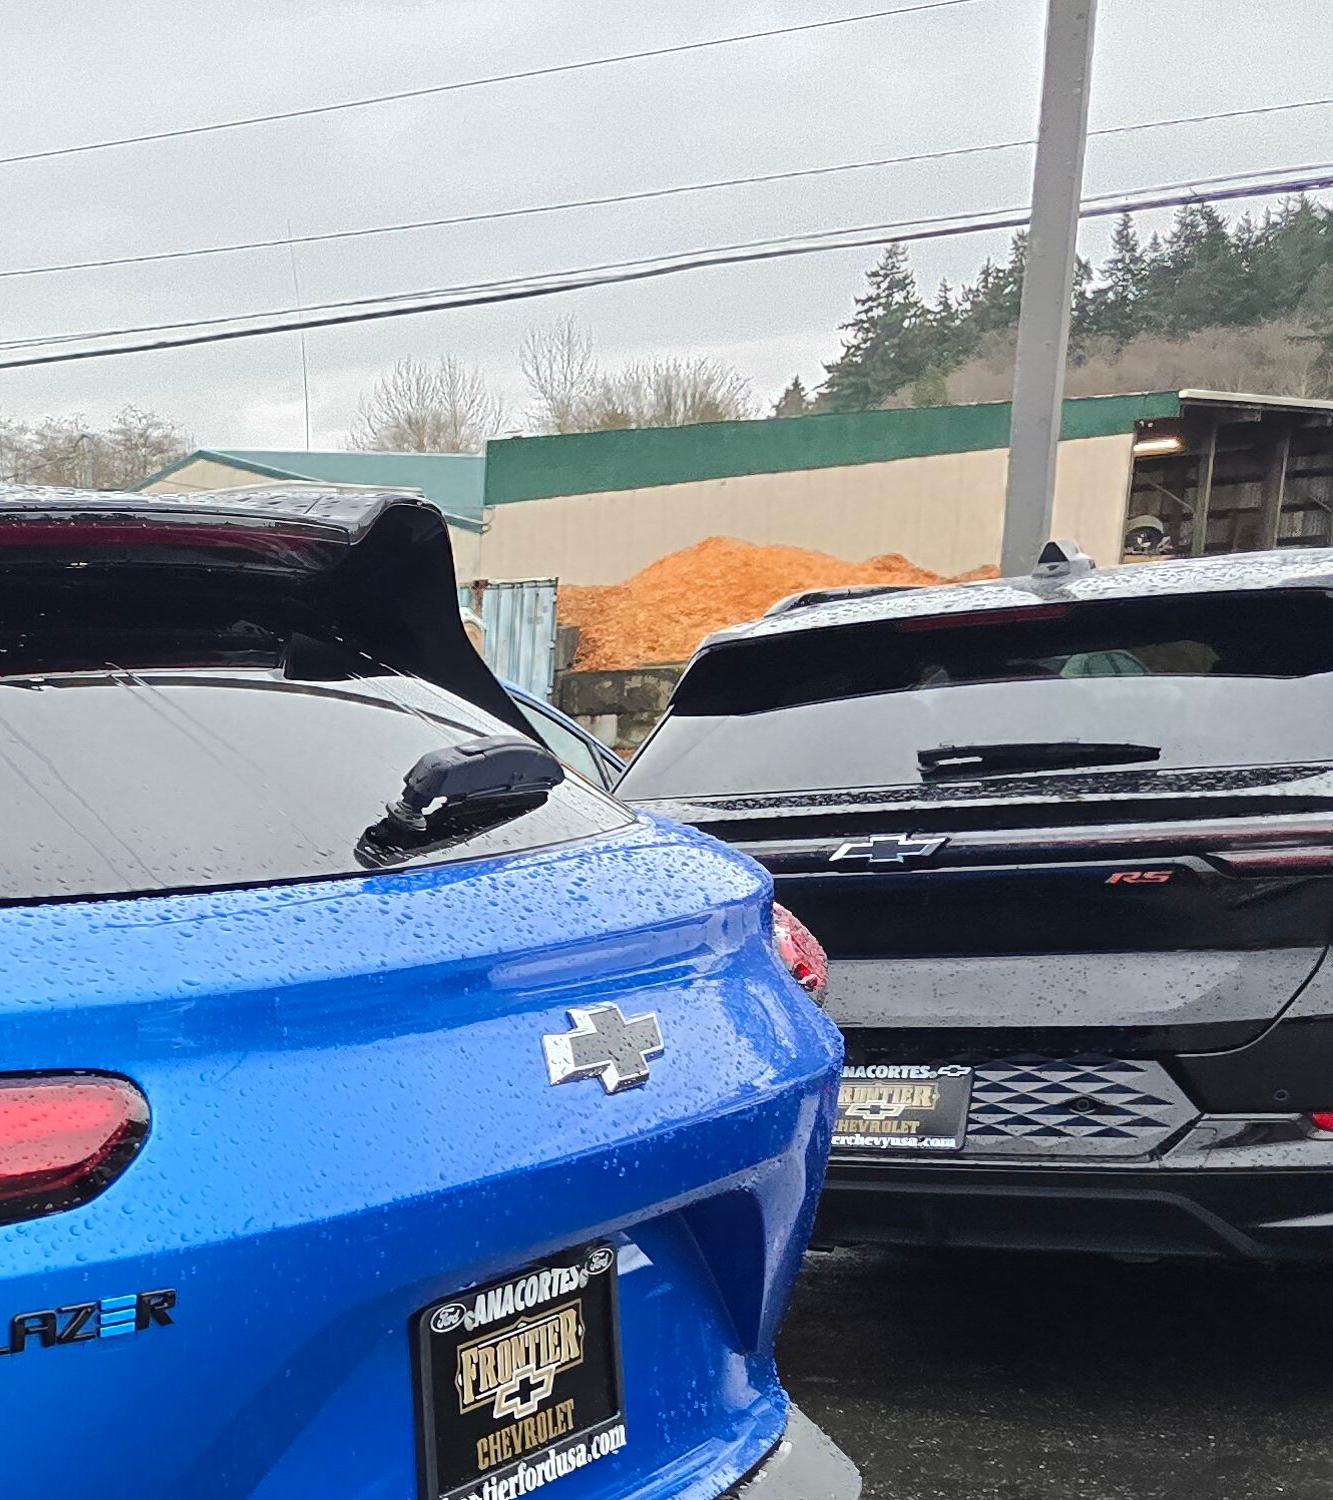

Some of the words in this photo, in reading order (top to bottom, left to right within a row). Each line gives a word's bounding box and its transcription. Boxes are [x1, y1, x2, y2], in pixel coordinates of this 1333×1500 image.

[1105, 871, 1173, 884] RS
[840, 1065, 931, 1079] NACORTES
[838, 1086, 933, 1107] RONTIER
[836, 1119, 920, 1133] HEVROLET
[831, 1134, 956, 1148] erchevyusa.com
[472, 1265, 580, 1328] ANACORTES
[460, 1308, 581, 1405] FRONTIER
[476, 1399, 575, 1471] CHEVROLET
